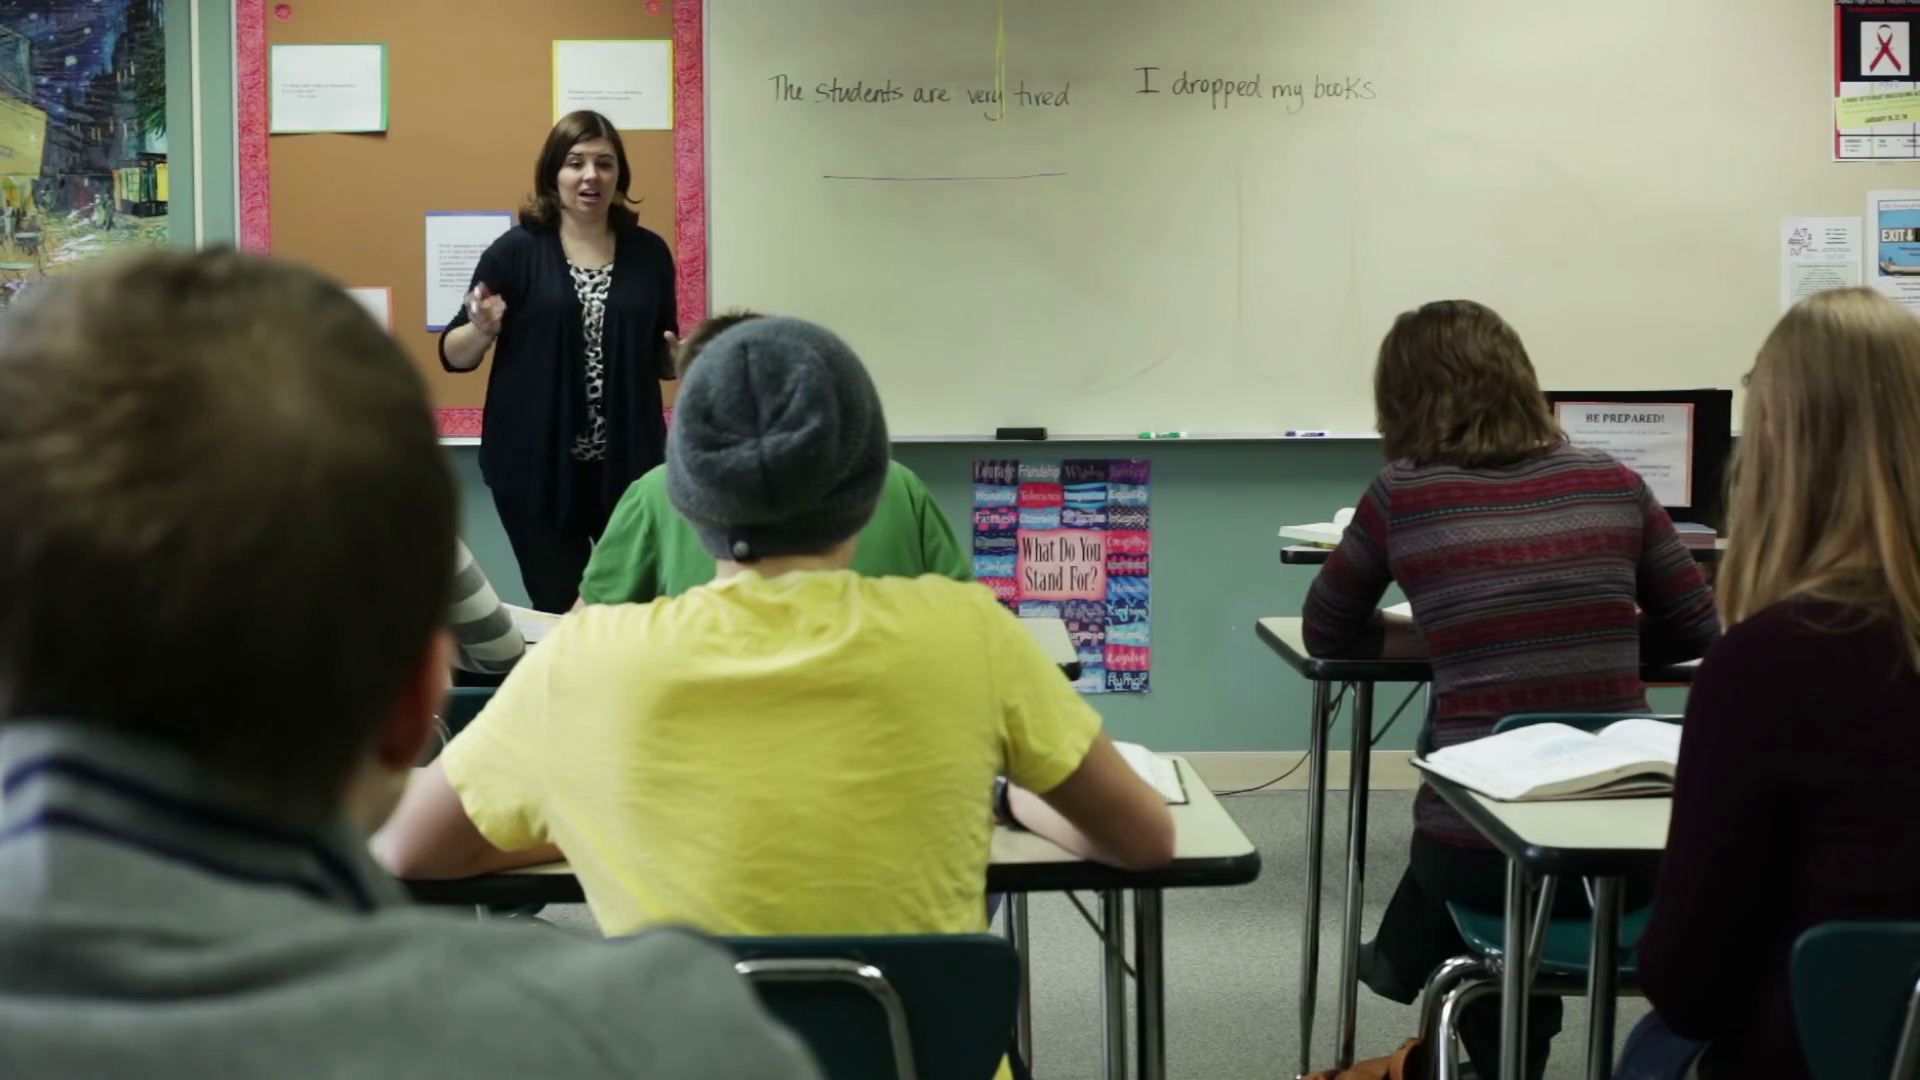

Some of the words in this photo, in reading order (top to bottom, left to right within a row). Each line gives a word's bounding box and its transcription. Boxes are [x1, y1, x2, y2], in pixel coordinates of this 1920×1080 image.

[768, 74, 803, 102] The
[815, 78, 903, 103] students
[914, 87, 951, 103] are
[968, 87, 1004, 121] very
[1014, 81, 1070, 107] tired
[1135, 66, 1160, 94] I
[1172, 71, 1262, 110] dropped
[1272, 83, 1303, 114] my
[1314, 74, 1377, 101] books
[1883, 229, 1905, 242] EXIT
[1586, 414, 1600, 423] BE
[1603, 413, 1665, 423] PREPARED!
[975, 463, 1017, 482] Courage
[1018, 464, 1060, 482] Friendship
[975, 491, 1017, 503] Honesty
[975, 512, 1017, 524] Fairness
[1022, 536, 1056, 563] What
[1060, 536, 1077, 563] Do
[1079, 536, 1101, 563] You
[1025, 566, 1063, 592] Stand
[1070, 566, 1098, 592] For?
